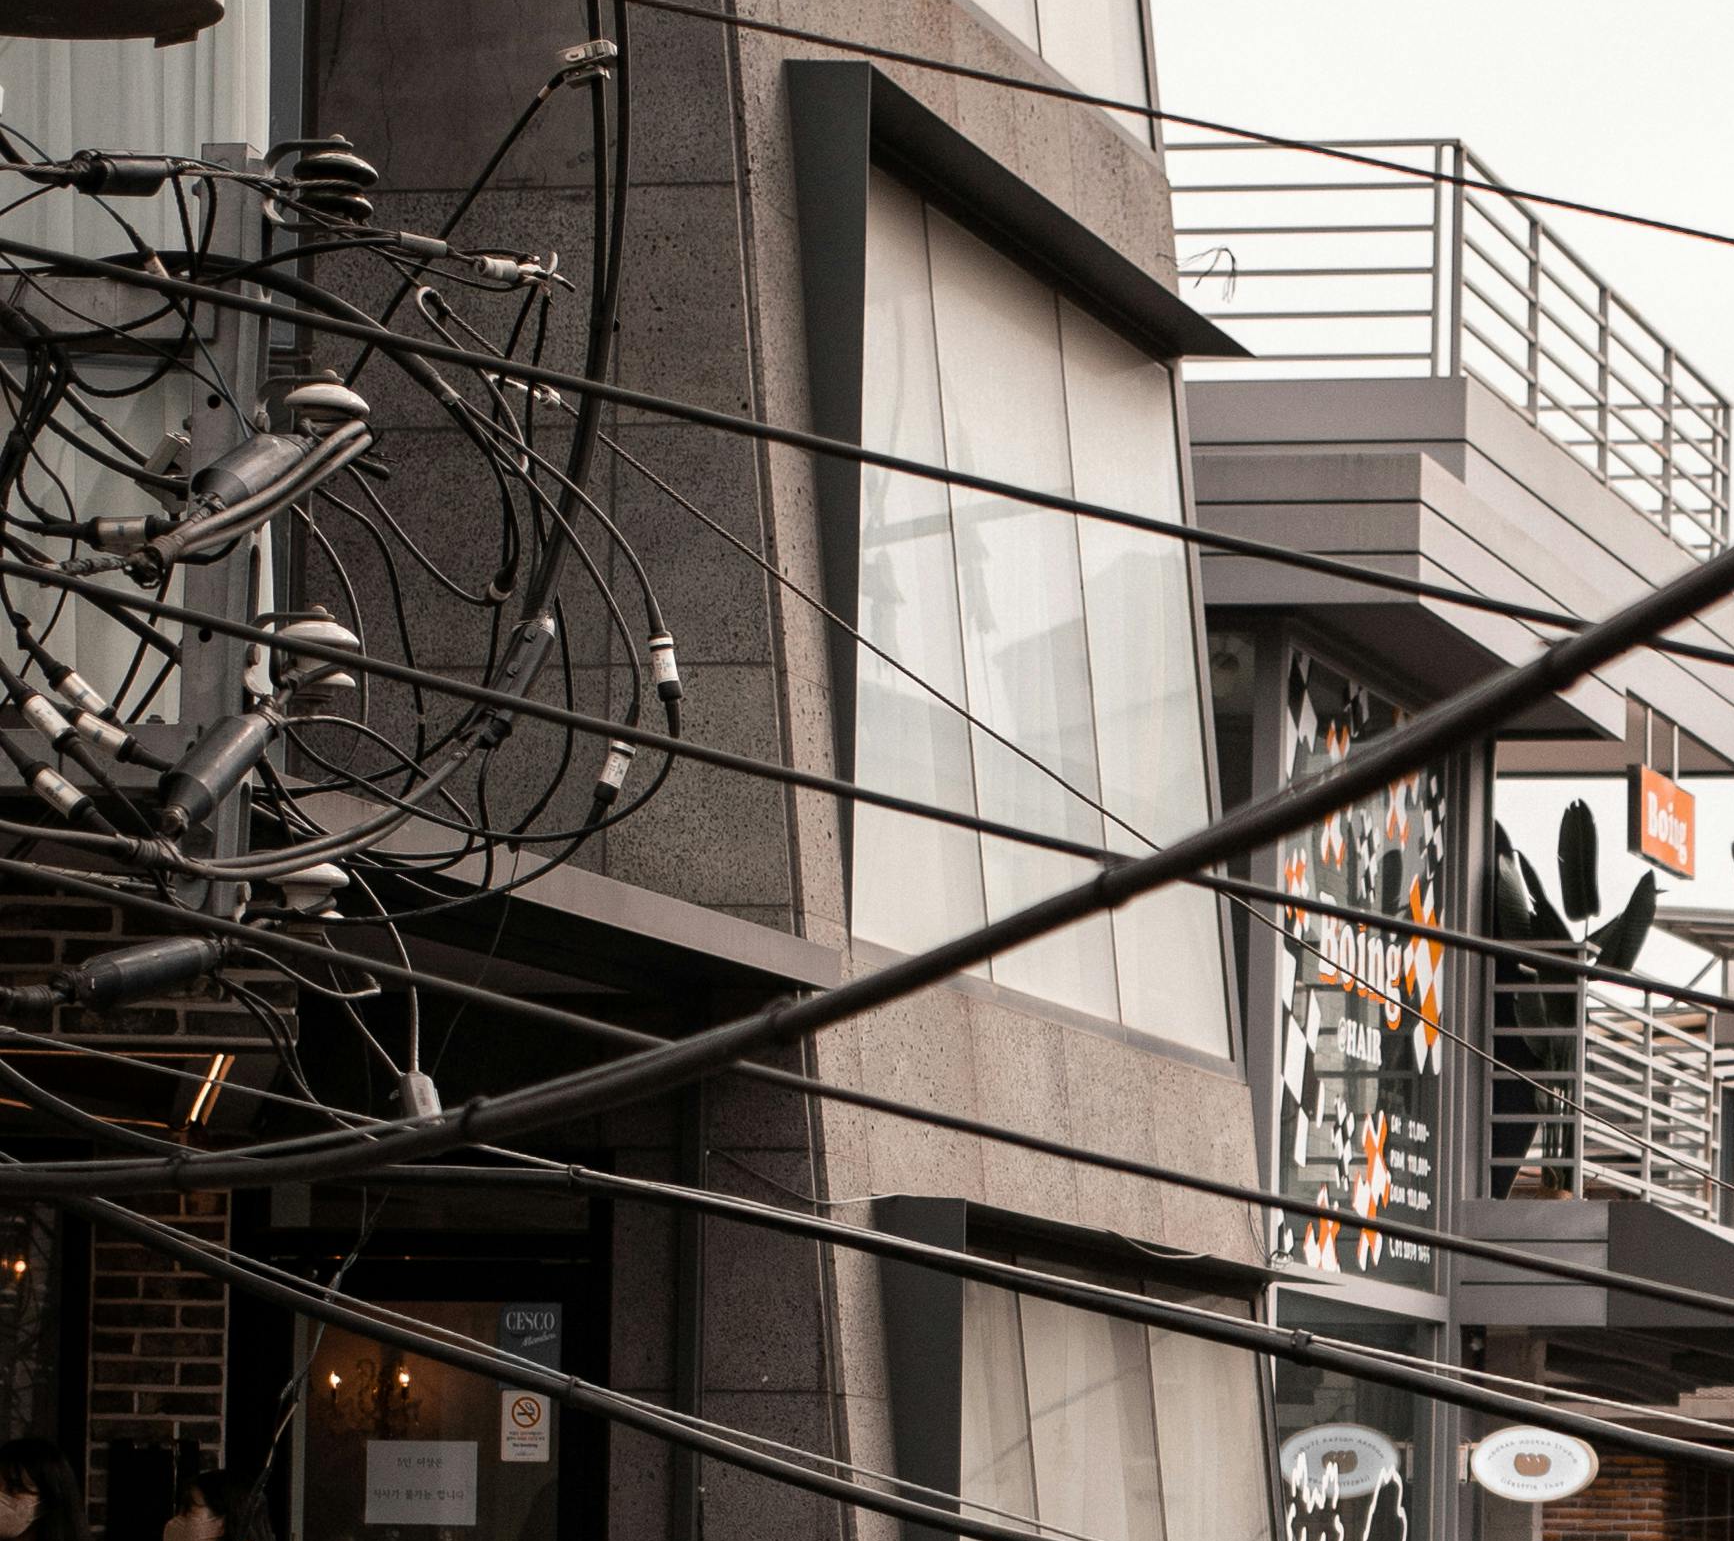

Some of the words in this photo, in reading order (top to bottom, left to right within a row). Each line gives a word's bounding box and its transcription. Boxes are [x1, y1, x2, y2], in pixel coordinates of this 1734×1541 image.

[1648, 791, 1688, 866] Boing
[1318, 890, 1402, 1031] Boing
[506, 1311, 556, 1331] CESCO
